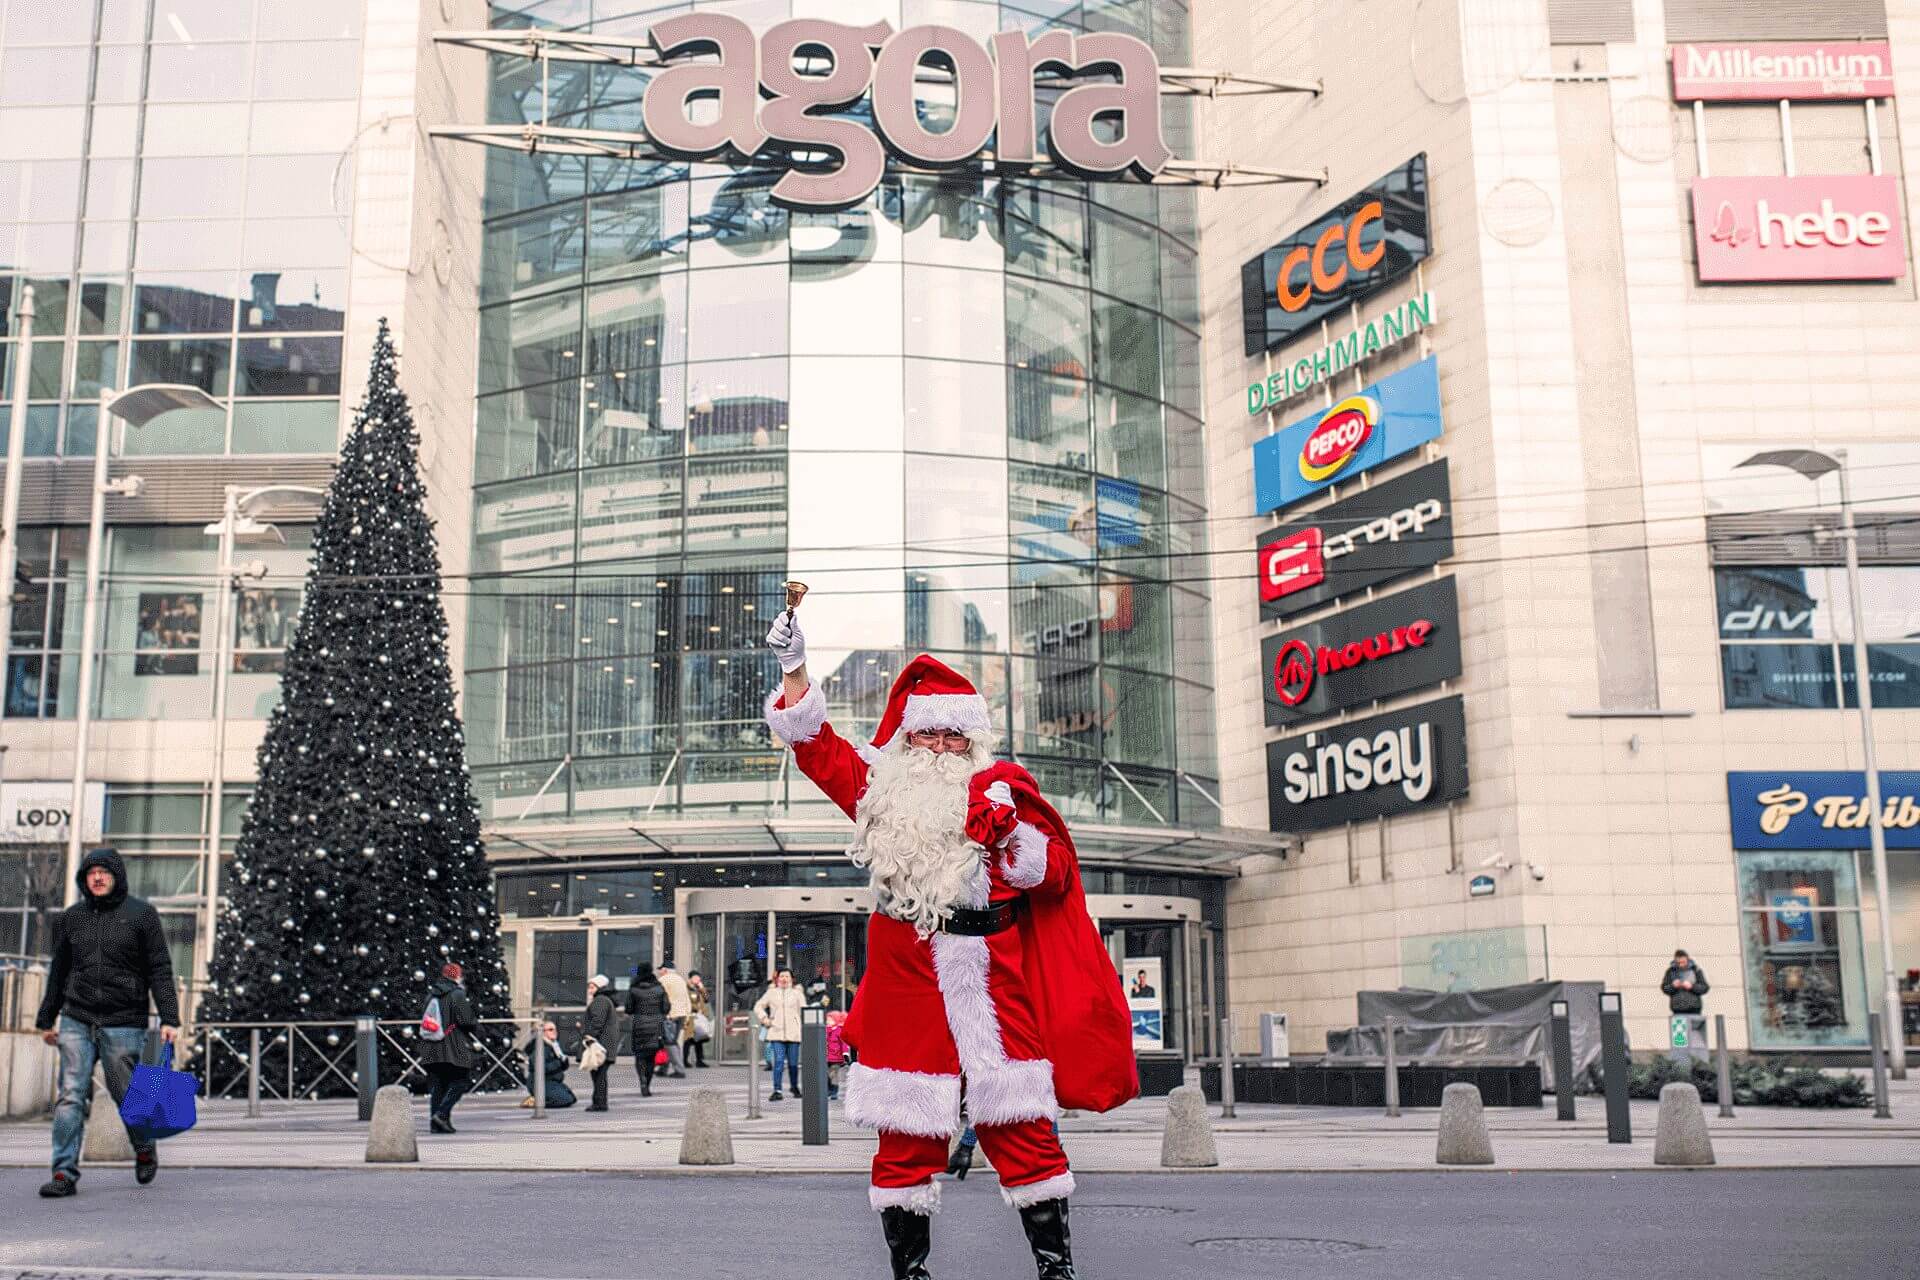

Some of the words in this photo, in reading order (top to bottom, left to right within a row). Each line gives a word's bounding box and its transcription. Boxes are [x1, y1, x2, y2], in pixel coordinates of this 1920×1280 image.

[1687, 44, 1882, 78] Millennium
[643, 12, 1173, 206] agora
[1757, 199, 1890, 247] hebe
[1277, 201, 1385, 312] CCC
[1247, 292, 1433, 414] DEICHMANN
[1309, 418, 1359, 460] PEPCO
[1323, 499, 1442, 559] cropp
[1316, 619, 1433, 676] house
[1284, 722, 1432, 804] sinsay
